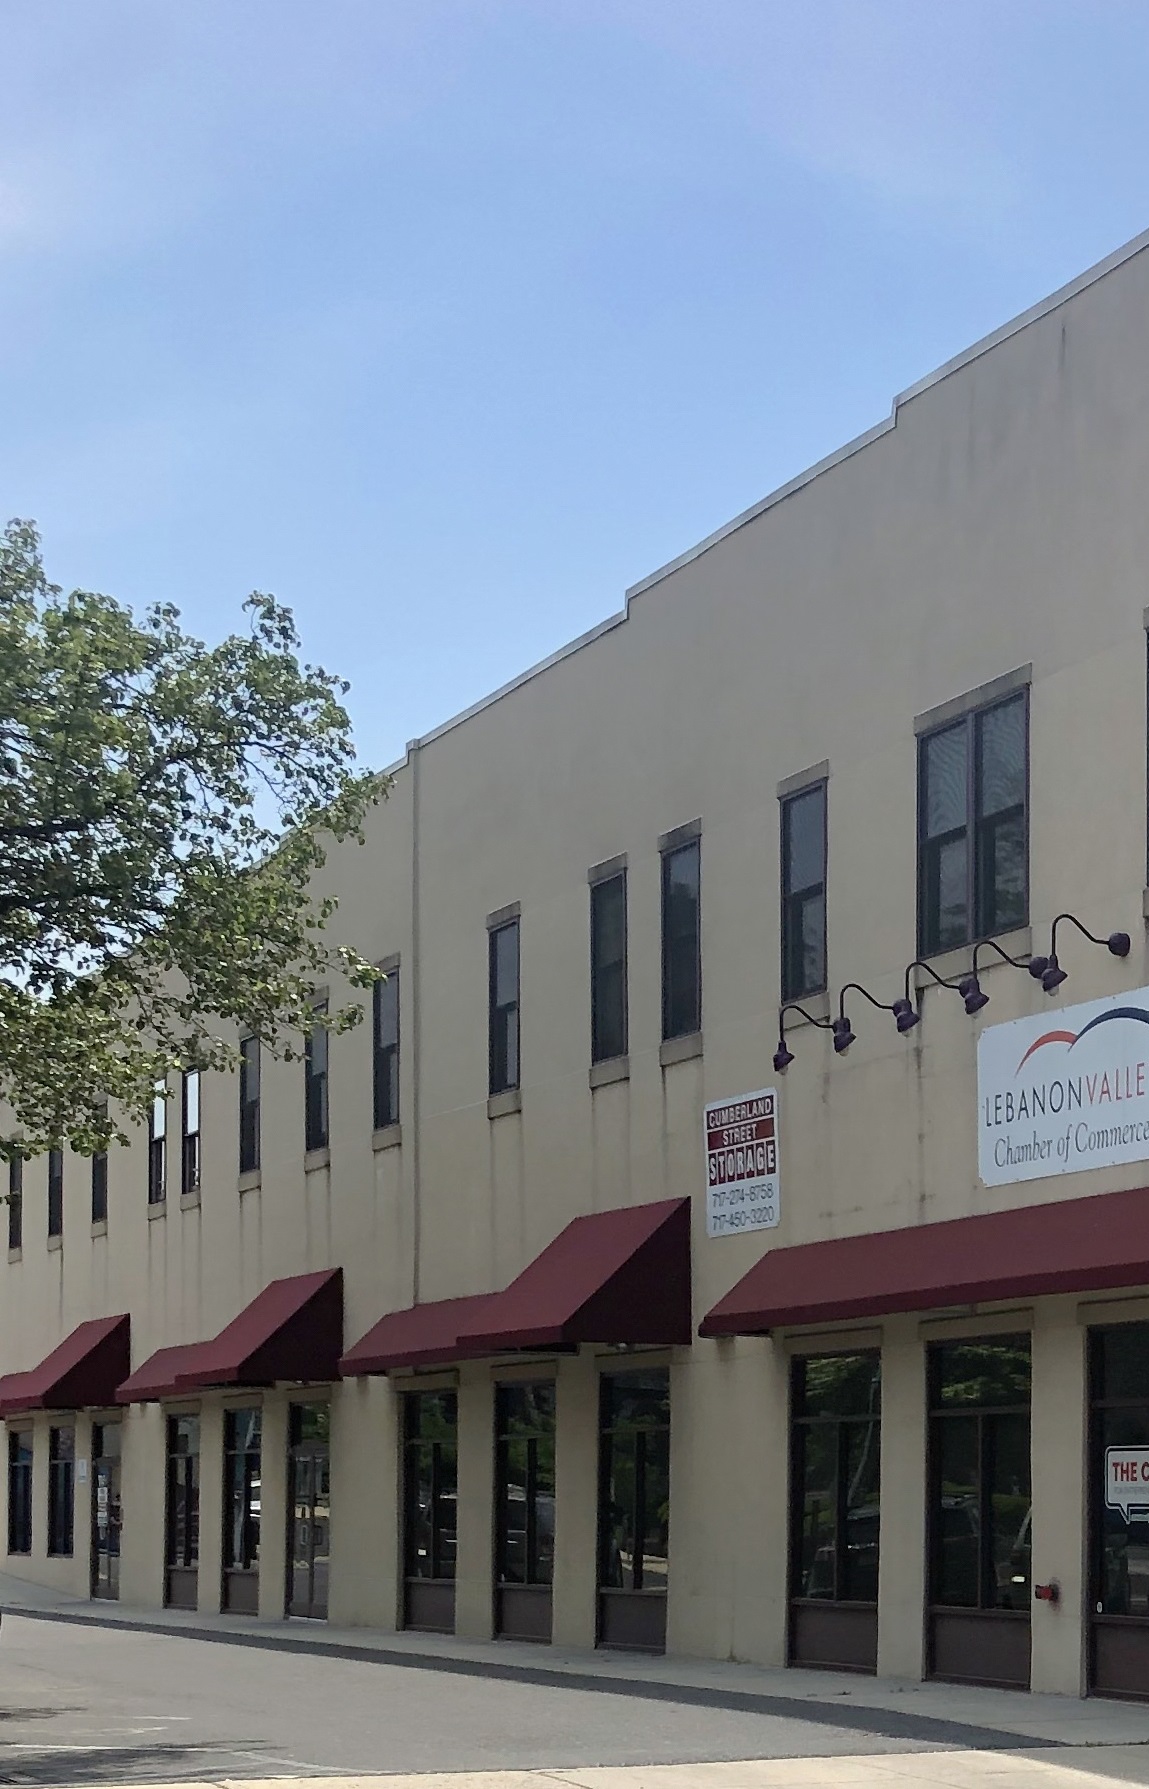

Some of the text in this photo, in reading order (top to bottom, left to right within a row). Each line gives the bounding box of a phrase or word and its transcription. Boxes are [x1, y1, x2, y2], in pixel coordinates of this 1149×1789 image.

[709, 1098, 771, 1127] CUMBERLAND
[723, 1124, 757, 1146] STREET
[994, 1130, 1053, 1167] Chamber
[1057, 1124, 1073, 1163] of
[709, 1144, 774, 1180] STORAGE
[712, 1182, 774, 1208] 717-274-8758
[712, 1205, 774, 1231] 717-450-3220
[1112, 1461, 1138, 1482] THE
